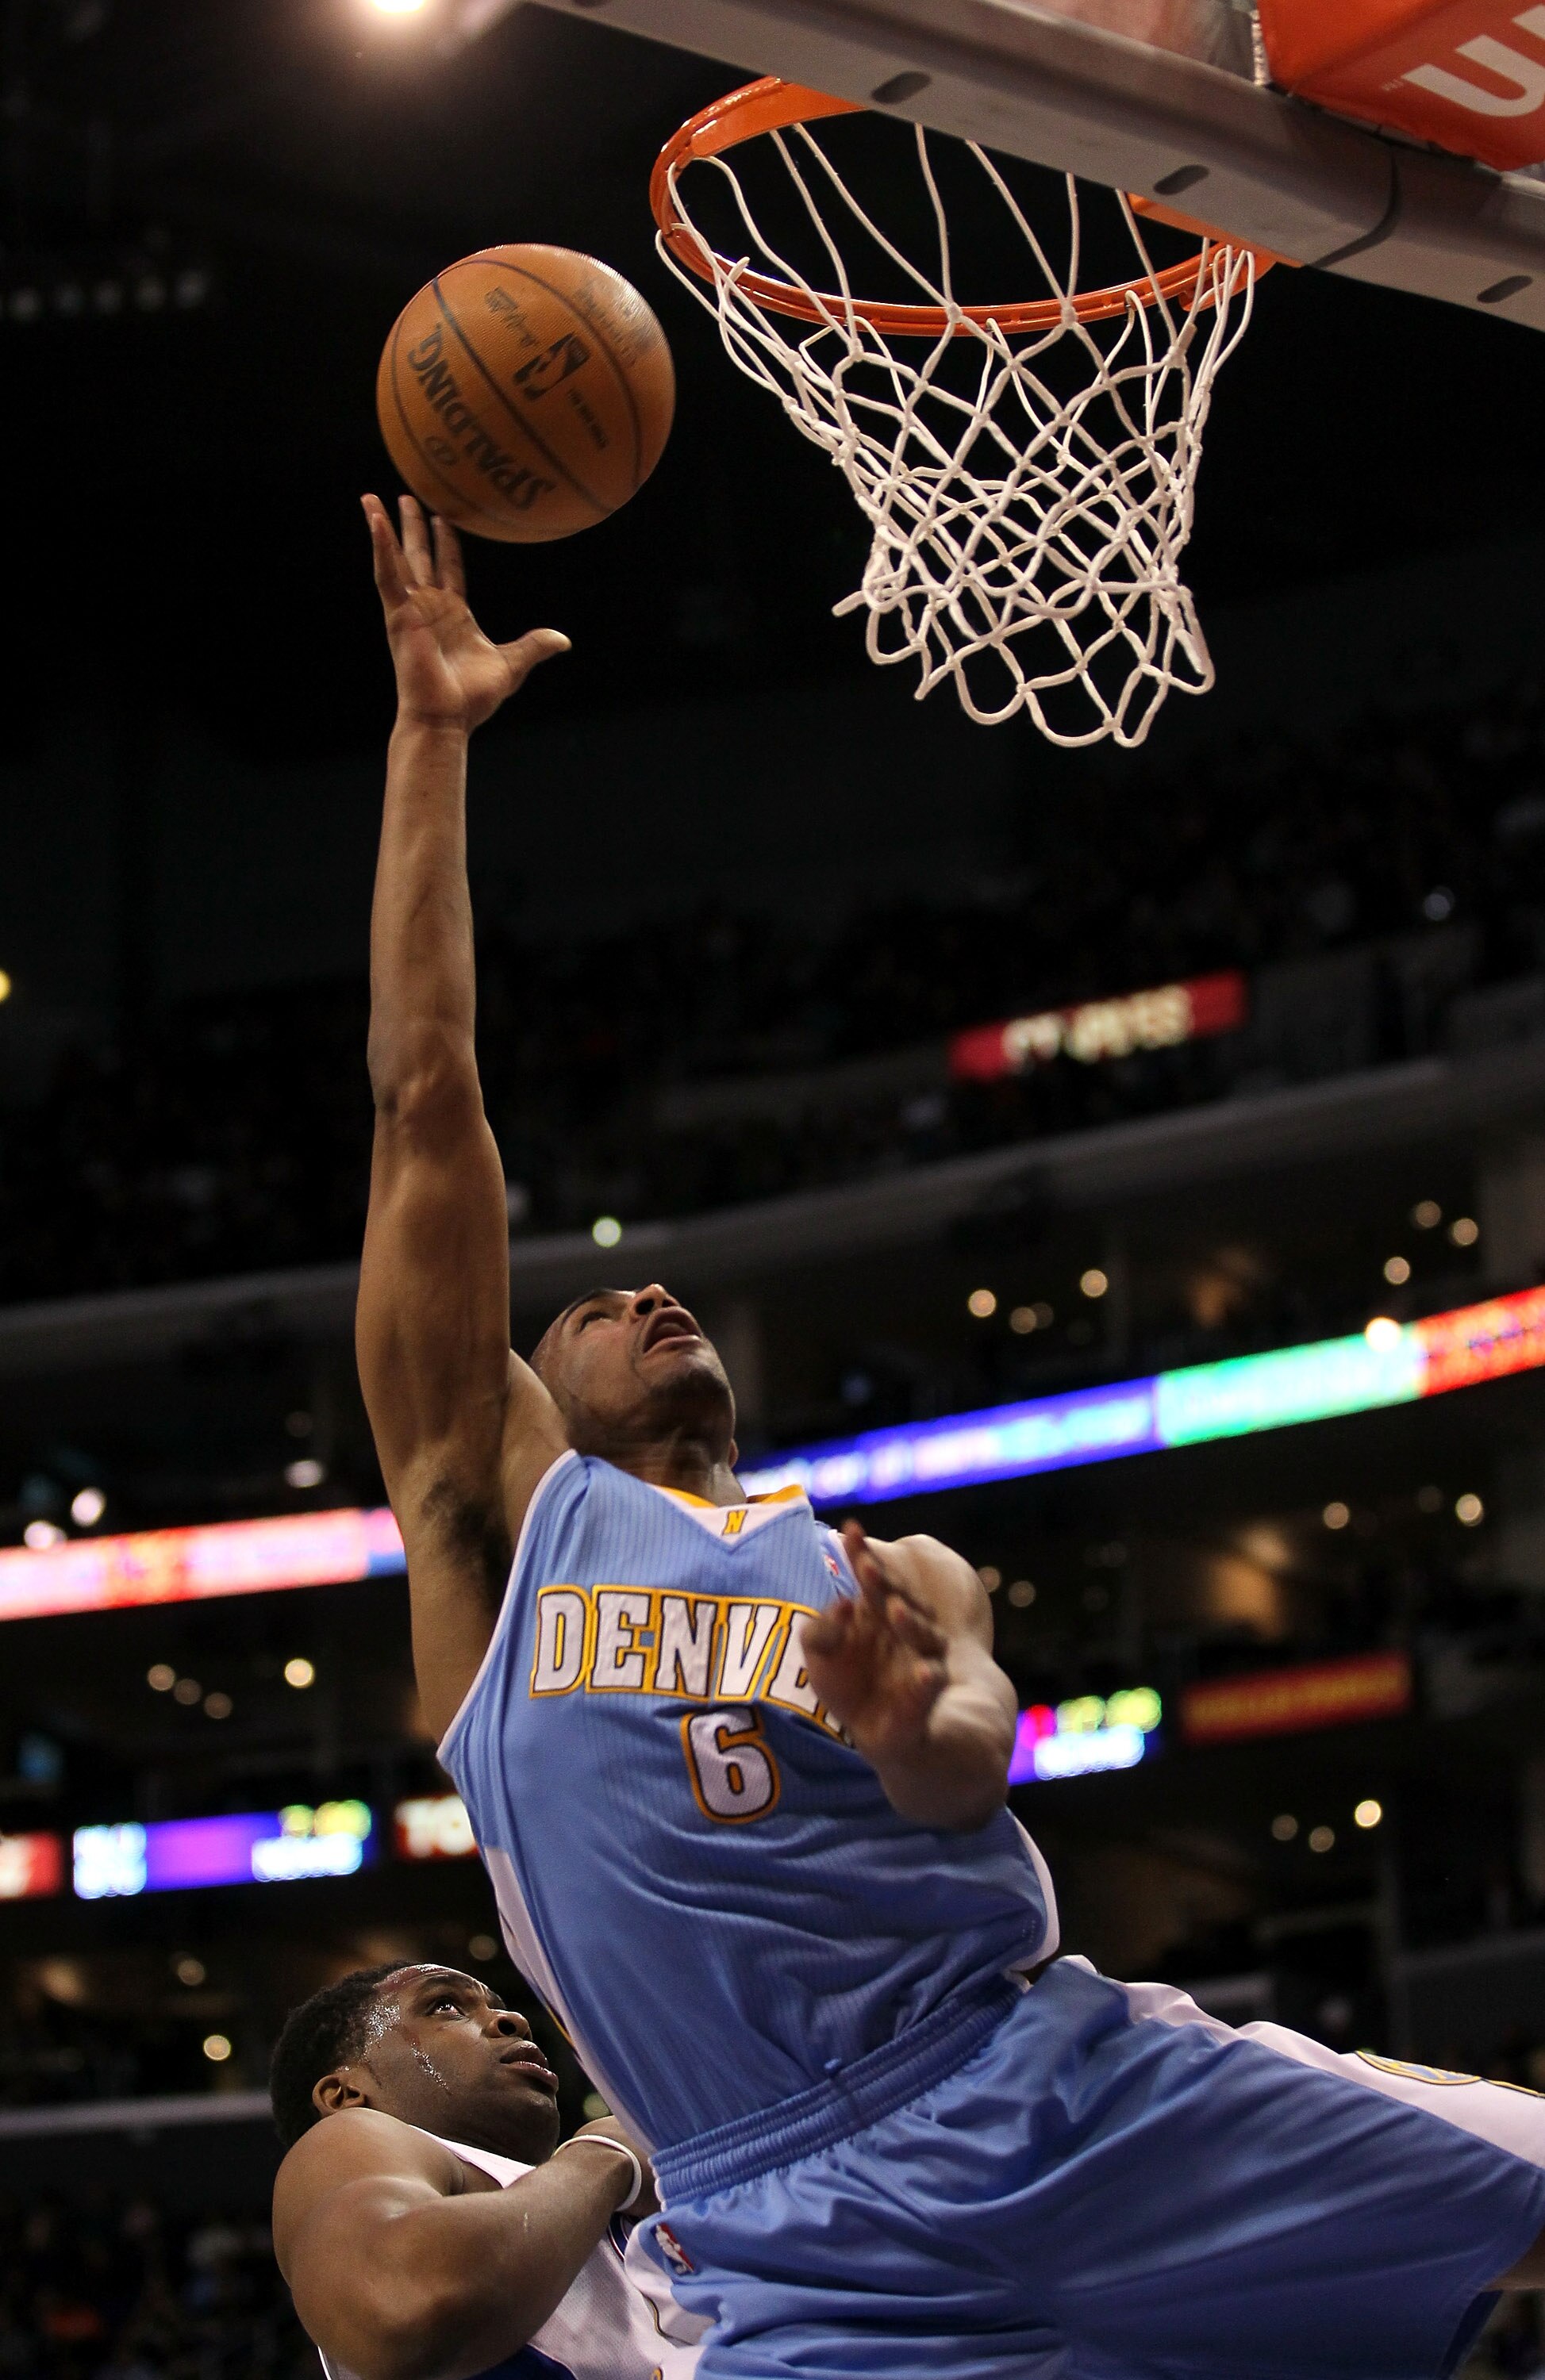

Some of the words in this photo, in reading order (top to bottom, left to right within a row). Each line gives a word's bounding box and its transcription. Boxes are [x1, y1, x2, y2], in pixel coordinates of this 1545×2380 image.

[1401, 4, 1545, 117] U
[406, 322, 556, 511] SPALDING
[529, 1583, 854, 1748] DENVE
[680, 1707, 781, 1825] 6
